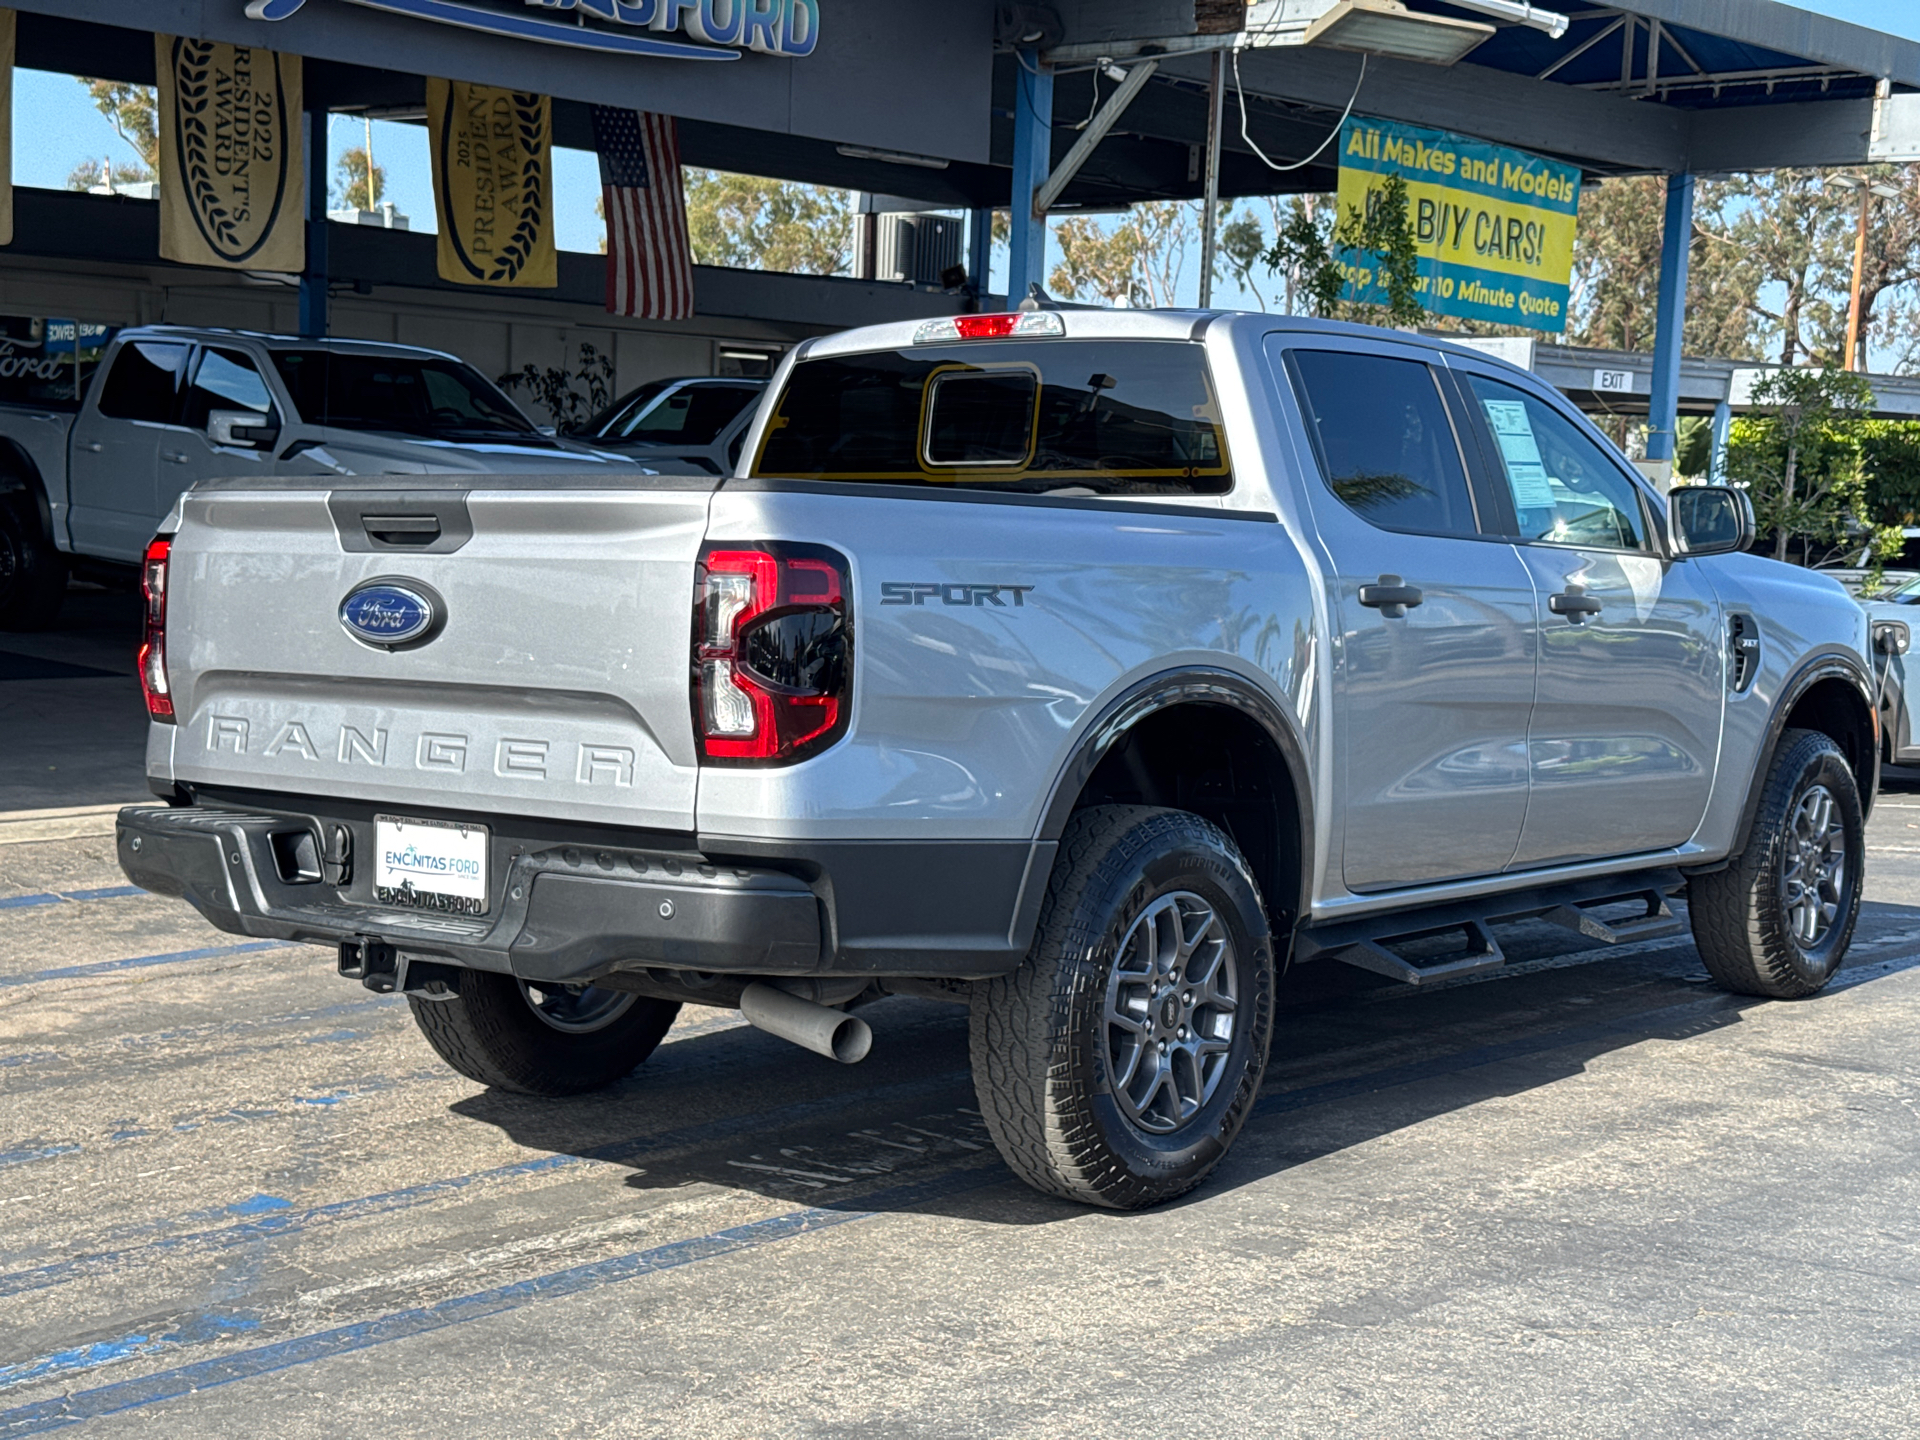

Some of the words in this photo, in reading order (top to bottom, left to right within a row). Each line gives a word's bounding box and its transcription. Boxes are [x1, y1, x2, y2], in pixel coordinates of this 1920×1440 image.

[215, 68, 232, 176] AWARD
[233, 46, 250, 222] RESIDENT'S
[253, 91, 273, 162] 2022
[457, 131, 470, 168] 2025
[494, 97, 520, 216] AWARD
[1347, 128, 1380, 159] All
[1382, 134, 1456, 175] Makes
[1460, 157, 1500, 187] and
[1502, 162, 1575, 203] Models
[1417, 198, 1471, 250] BUY
[1473, 210, 1545, 266] CARS!
[1458, 280, 1515, 310] Minute
[1518, 292, 1560, 317] Quote
[1602, 372, 1625, 389] EXIT
[358, 597, 405, 629] Ford
[880, 582, 1035, 607] SPORT
[206, 715, 636, 788] RANGER
[386, 850, 446, 871] ENCINITAS
[449, 858, 479, 875] FORD
